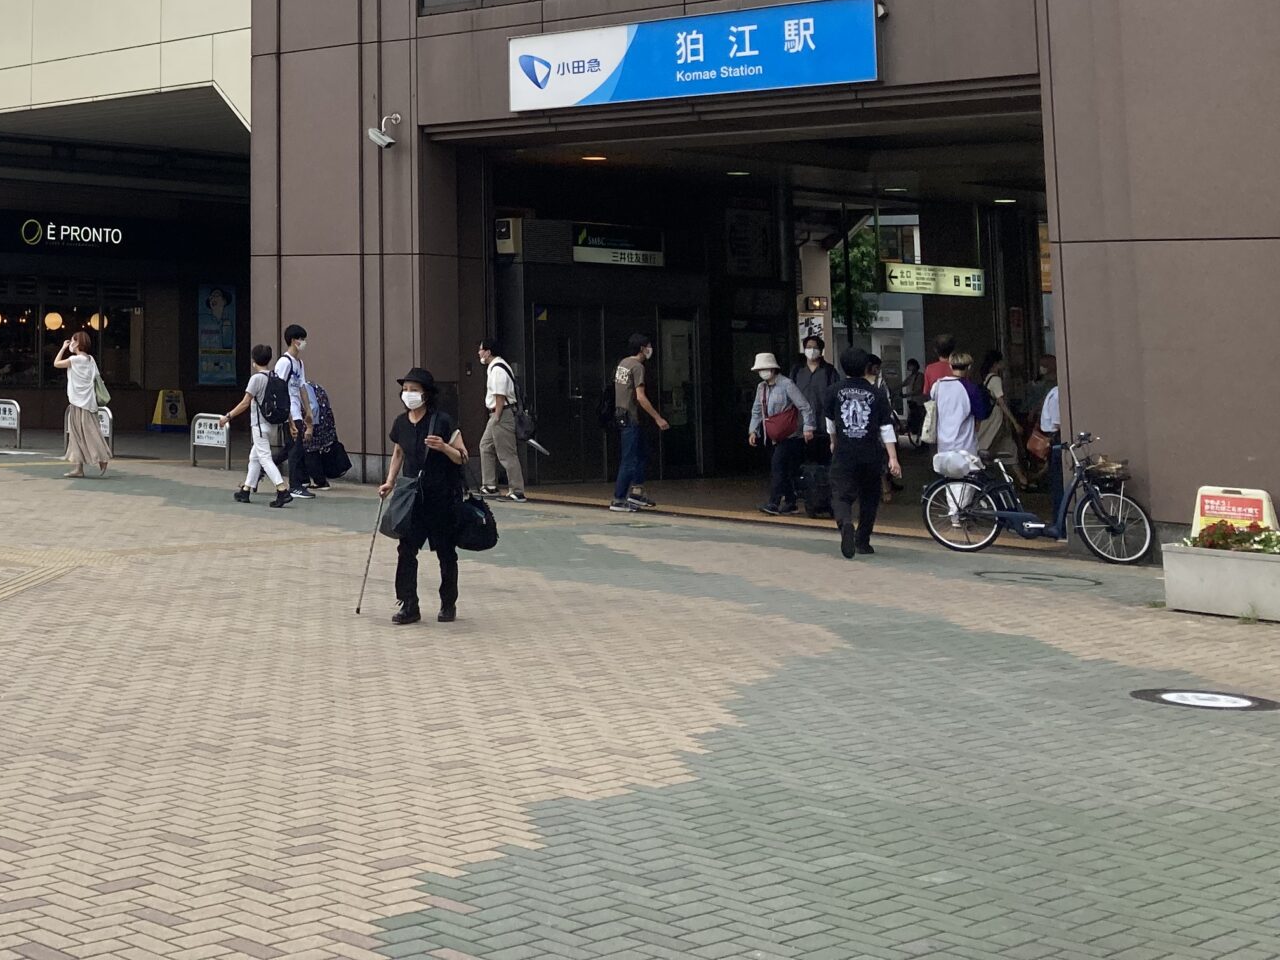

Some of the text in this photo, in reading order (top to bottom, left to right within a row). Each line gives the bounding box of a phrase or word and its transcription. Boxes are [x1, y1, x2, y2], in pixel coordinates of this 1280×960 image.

[676, 17, 816, 64] 狛江駅
[556, 58, 601, 76] 小田急
[676, 63, 763, 82] Komae Station
[47, 222, 122, 244] È PRONTO
